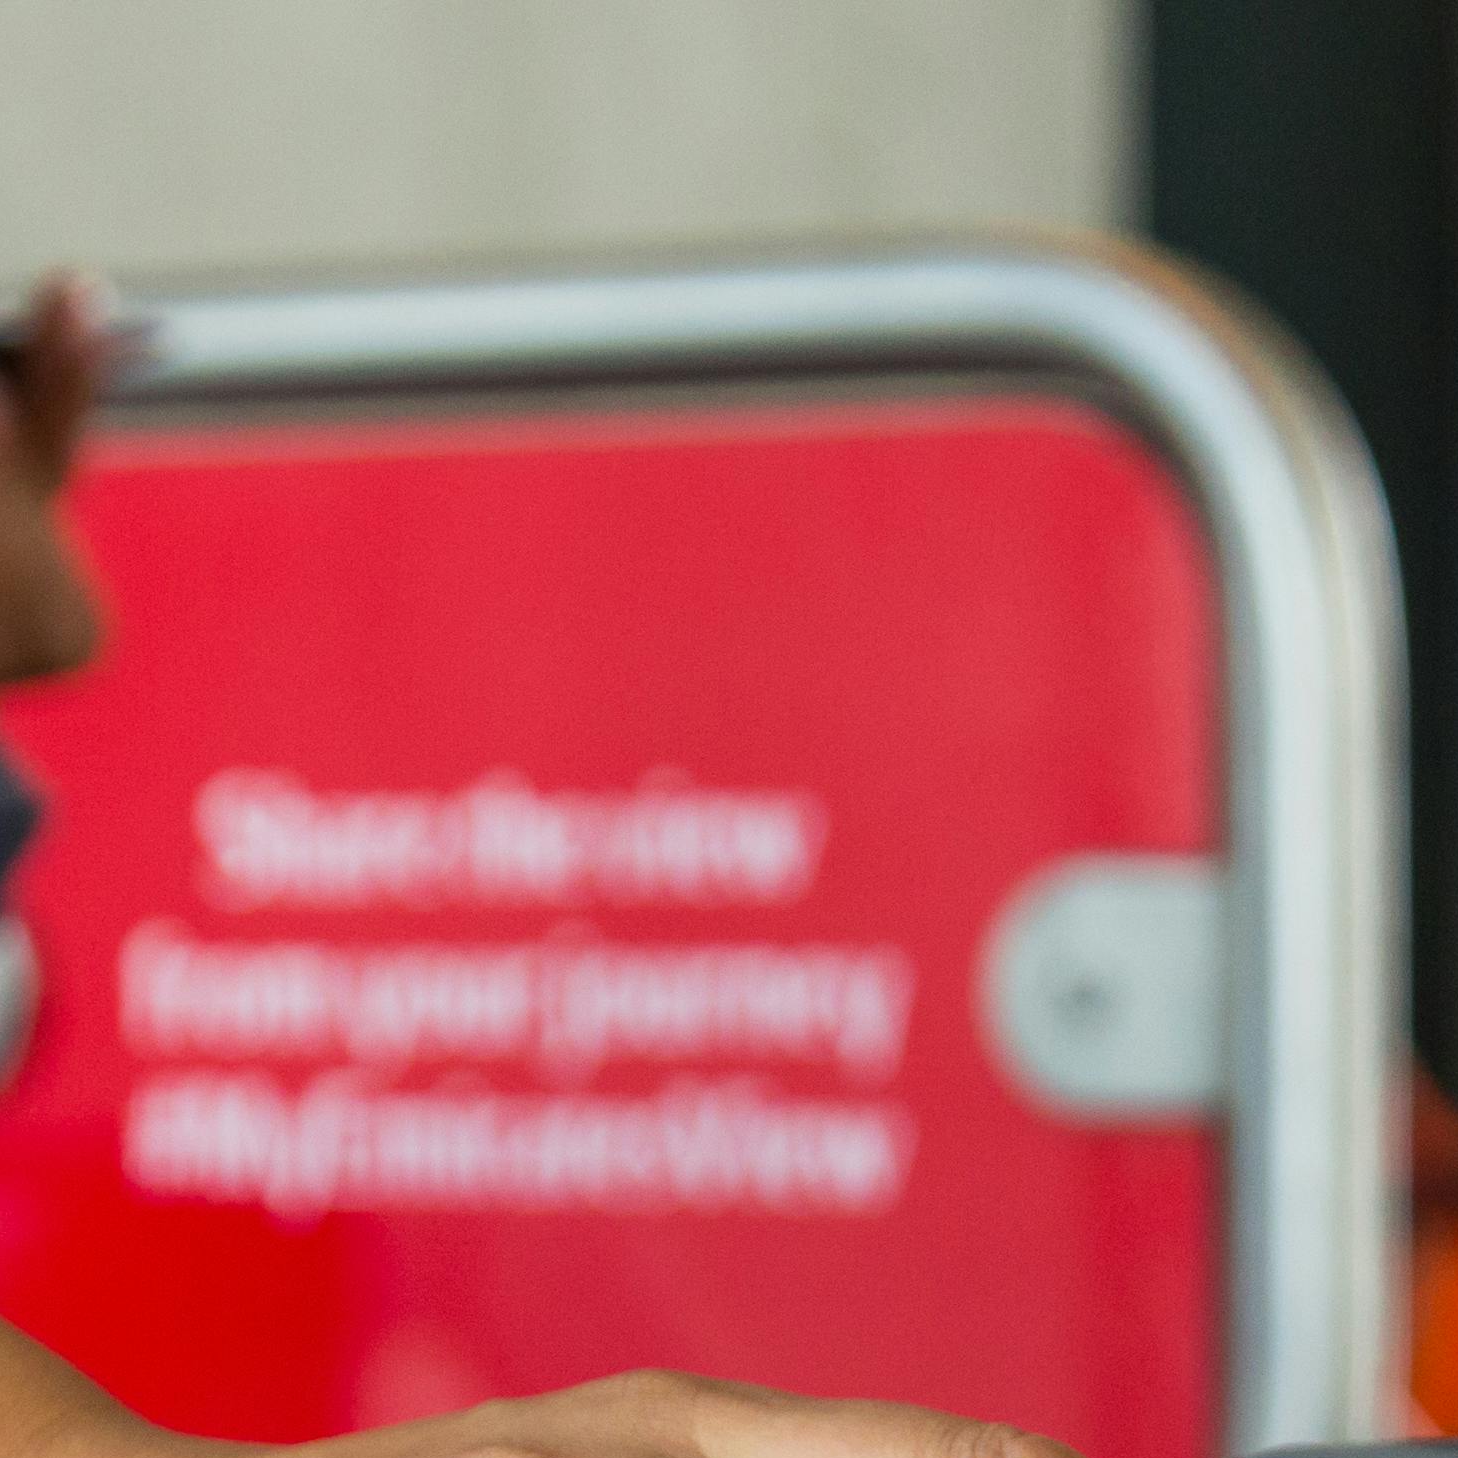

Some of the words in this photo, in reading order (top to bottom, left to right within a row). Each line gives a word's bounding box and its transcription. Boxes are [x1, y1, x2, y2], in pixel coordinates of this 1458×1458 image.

[198, 768, 434, 908] Share
[446, 768, 576, 904] the
[590, 768, 824, 902] view
[122, 917, 339, 1055] from
[347, 944, 530, 1084] your
[538, 918, 916, 1088] journey
